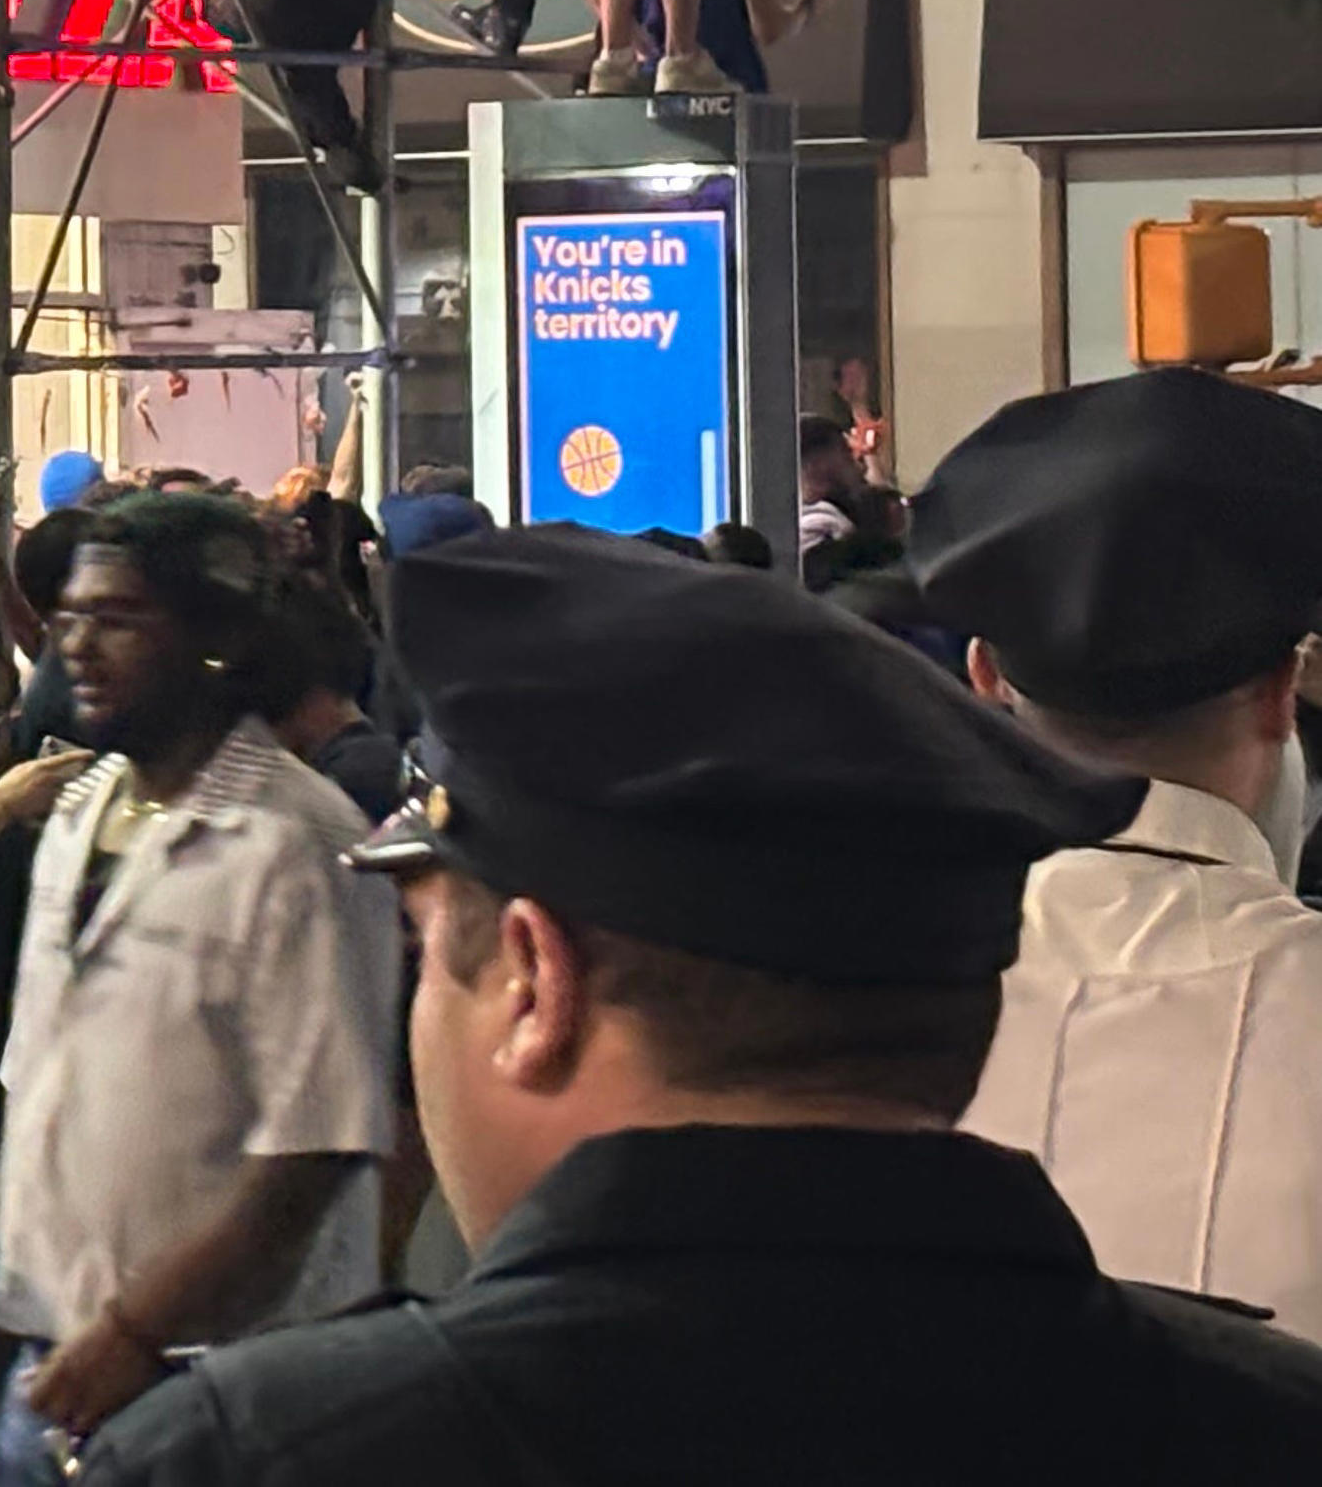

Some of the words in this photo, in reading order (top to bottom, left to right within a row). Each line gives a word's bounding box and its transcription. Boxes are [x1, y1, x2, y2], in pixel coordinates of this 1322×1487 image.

[532, 234, 647, 267] You're
[651, 229, 687, 265] in
[534, 268, 652, 304] Knicks
[534, 302, 679, 350] territory
